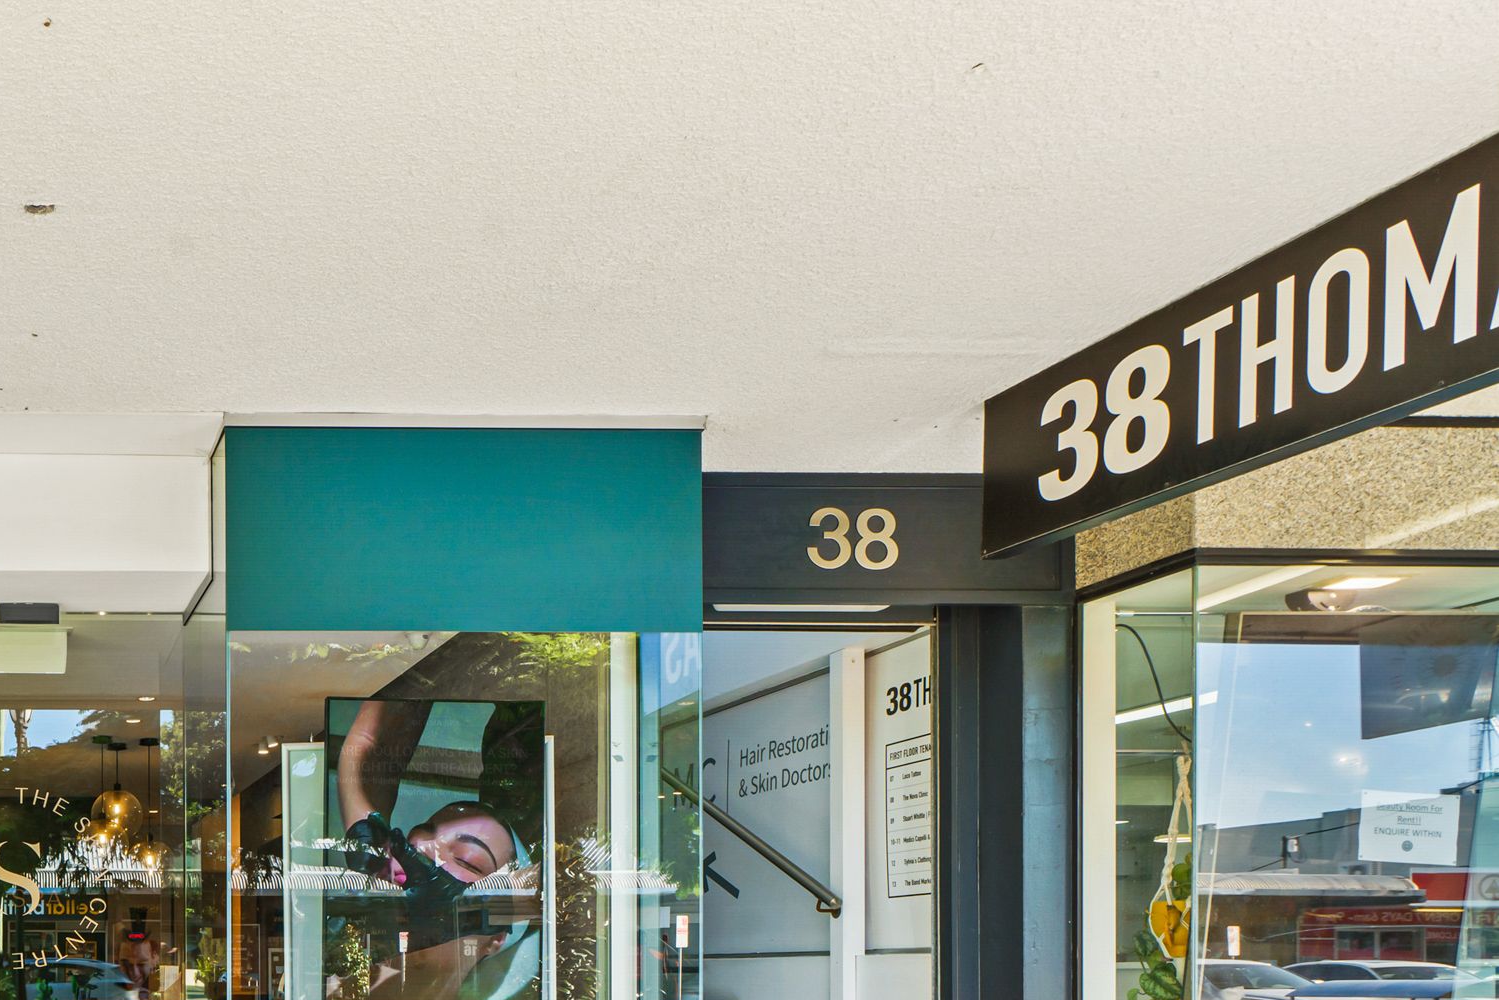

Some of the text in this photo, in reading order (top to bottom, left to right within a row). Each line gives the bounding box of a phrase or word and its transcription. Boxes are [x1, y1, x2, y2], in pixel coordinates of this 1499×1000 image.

[807, 507, 898, 570] 38
[740, 724, 829, 768] Hair Restorati
[889, 750, 902, 760] FIRST
[903, 747, 918, 758] FLOOR
[739, 762, 830, 798] & Skin Doctor
[15, 787, 70, 817] THE
[1405, 803, 1428, 812] Room
[1430, 804, 1444, 813] For
[1374, 827, 1442, 838] ENQUIRE WITHIN
[11, 896, 107, 970] CENTRE
